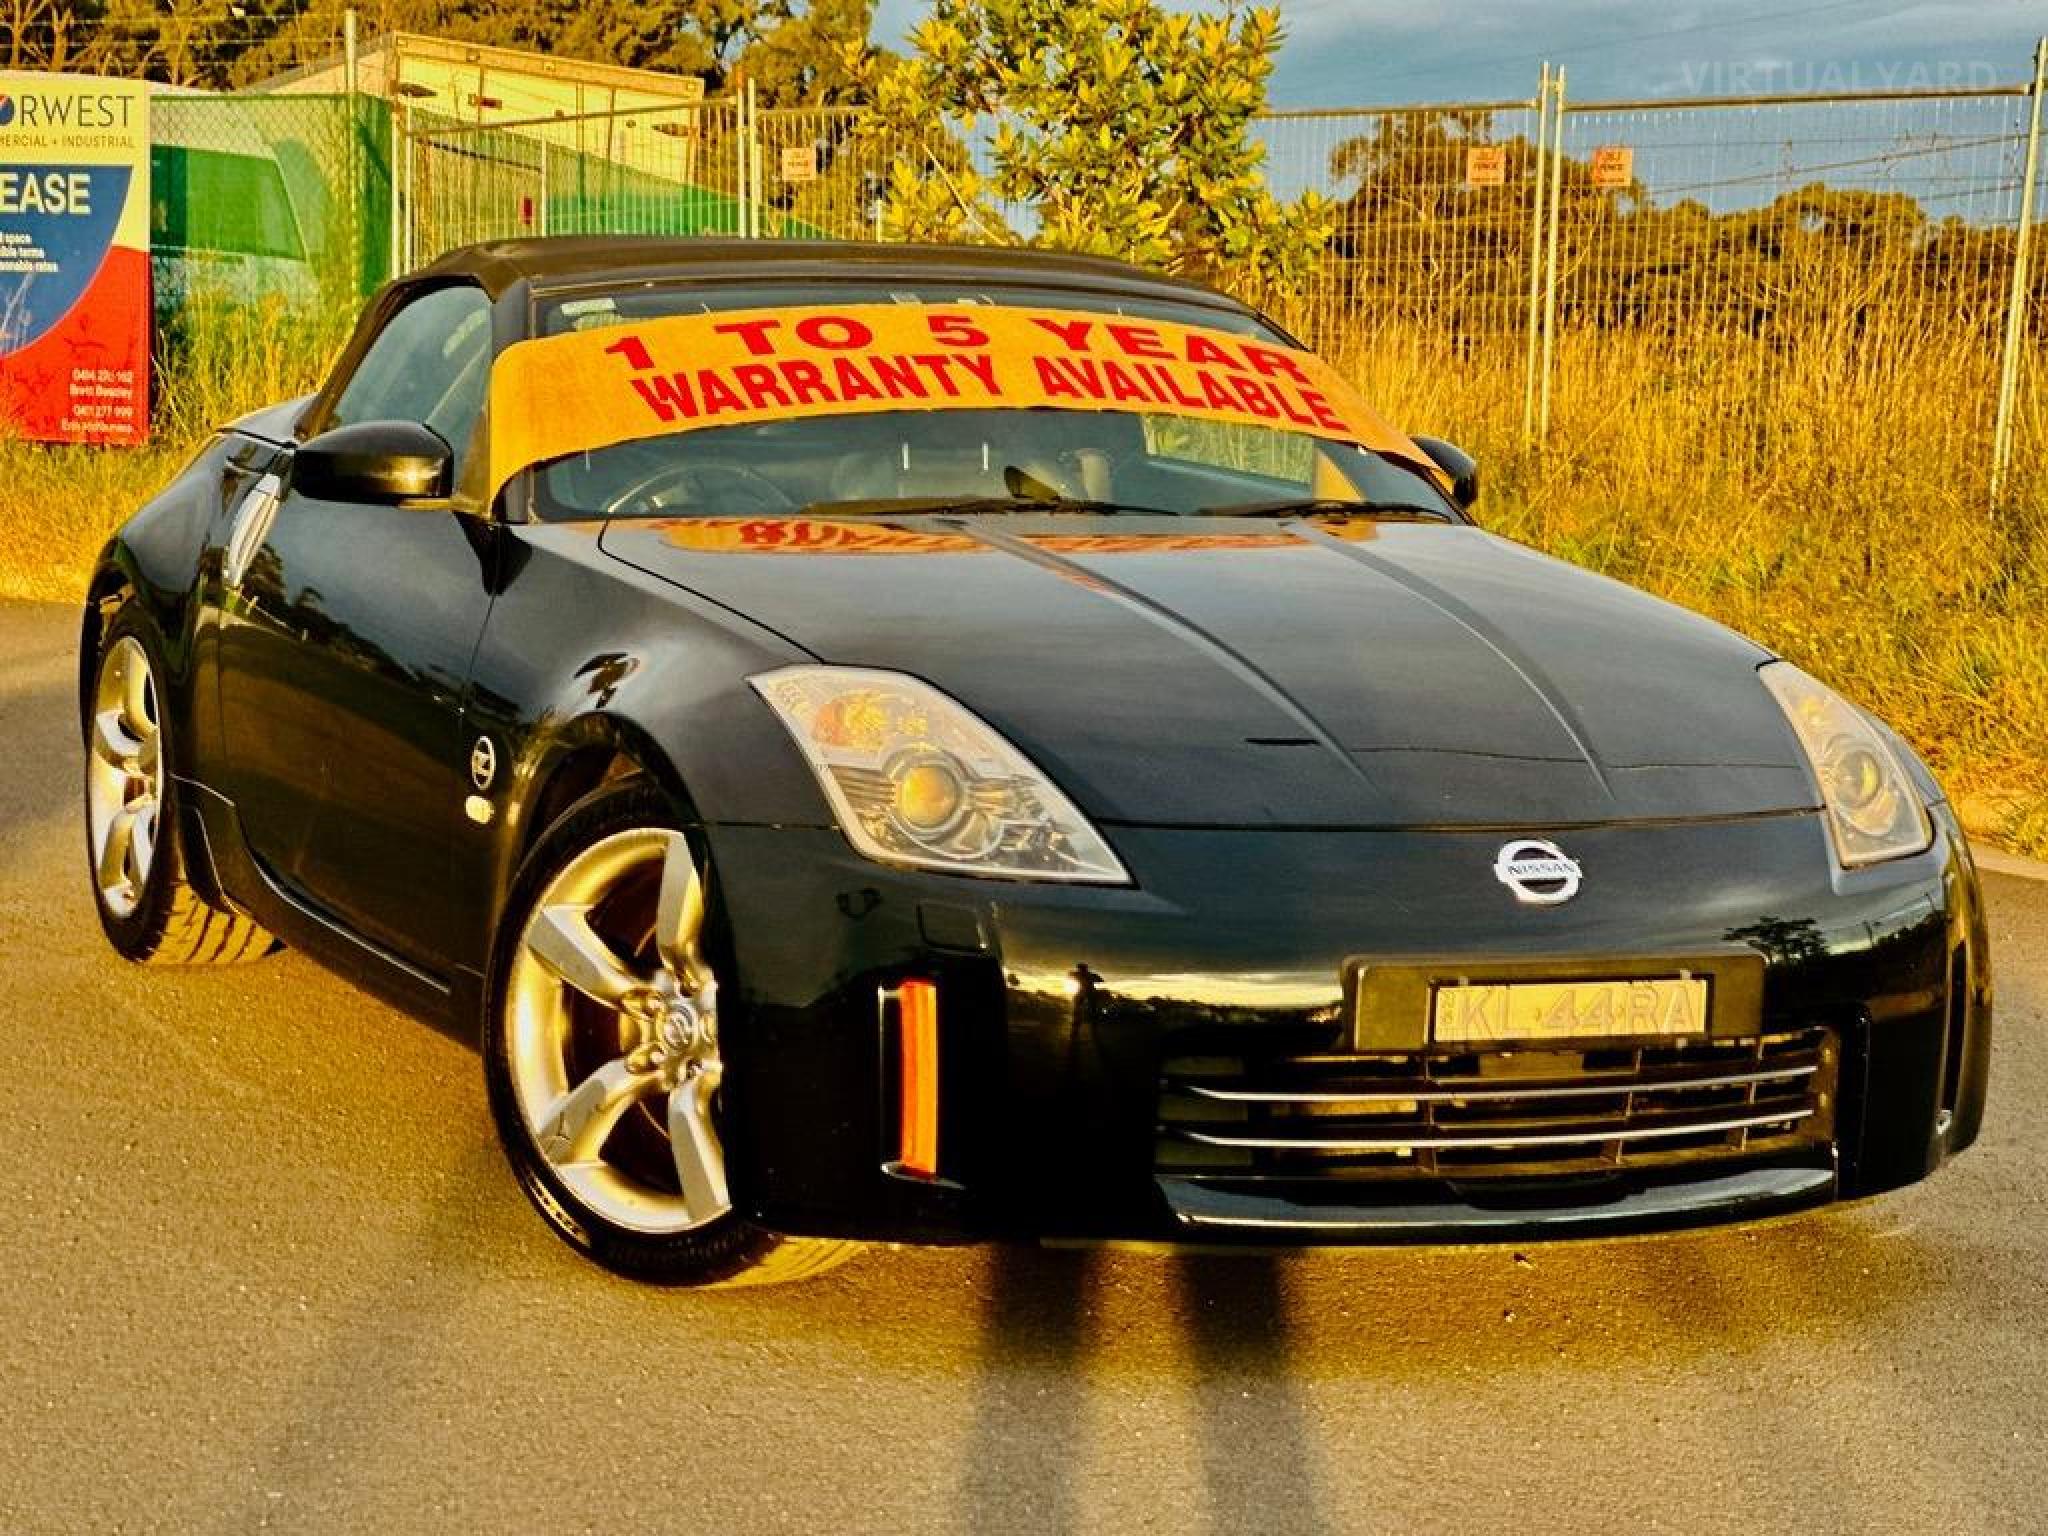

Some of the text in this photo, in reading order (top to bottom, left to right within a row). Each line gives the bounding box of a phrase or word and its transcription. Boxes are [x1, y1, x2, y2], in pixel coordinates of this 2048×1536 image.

[62, 135, 135, 149] INDUSTRIAL
[0, 171, 91, 215] EASE
[605, 315, 1314, 385] 1 TO 5 YEAR
[630, 354, 1351, 432] WARRANTY AVAILABLE
[1506, 862, 1576, 876] NISSAN
